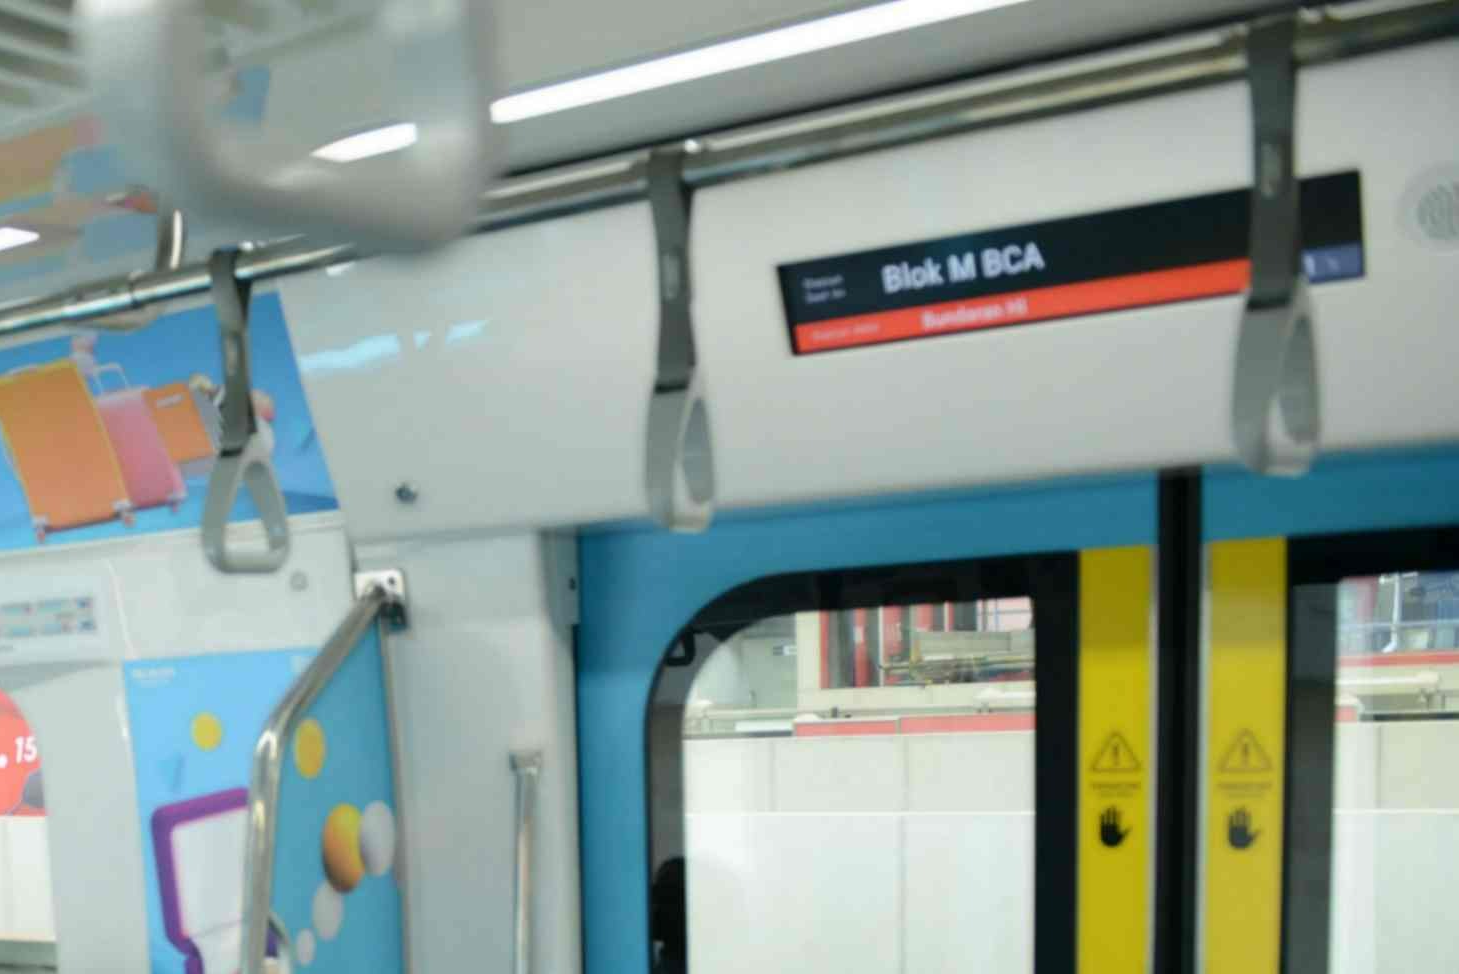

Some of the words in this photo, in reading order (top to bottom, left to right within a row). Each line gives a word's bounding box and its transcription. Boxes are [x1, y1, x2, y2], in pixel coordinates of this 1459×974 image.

[881, 257, 944, 294] Blok
[947, 252, 978, 282] M
[980, 241, 1045, 278] BCA
